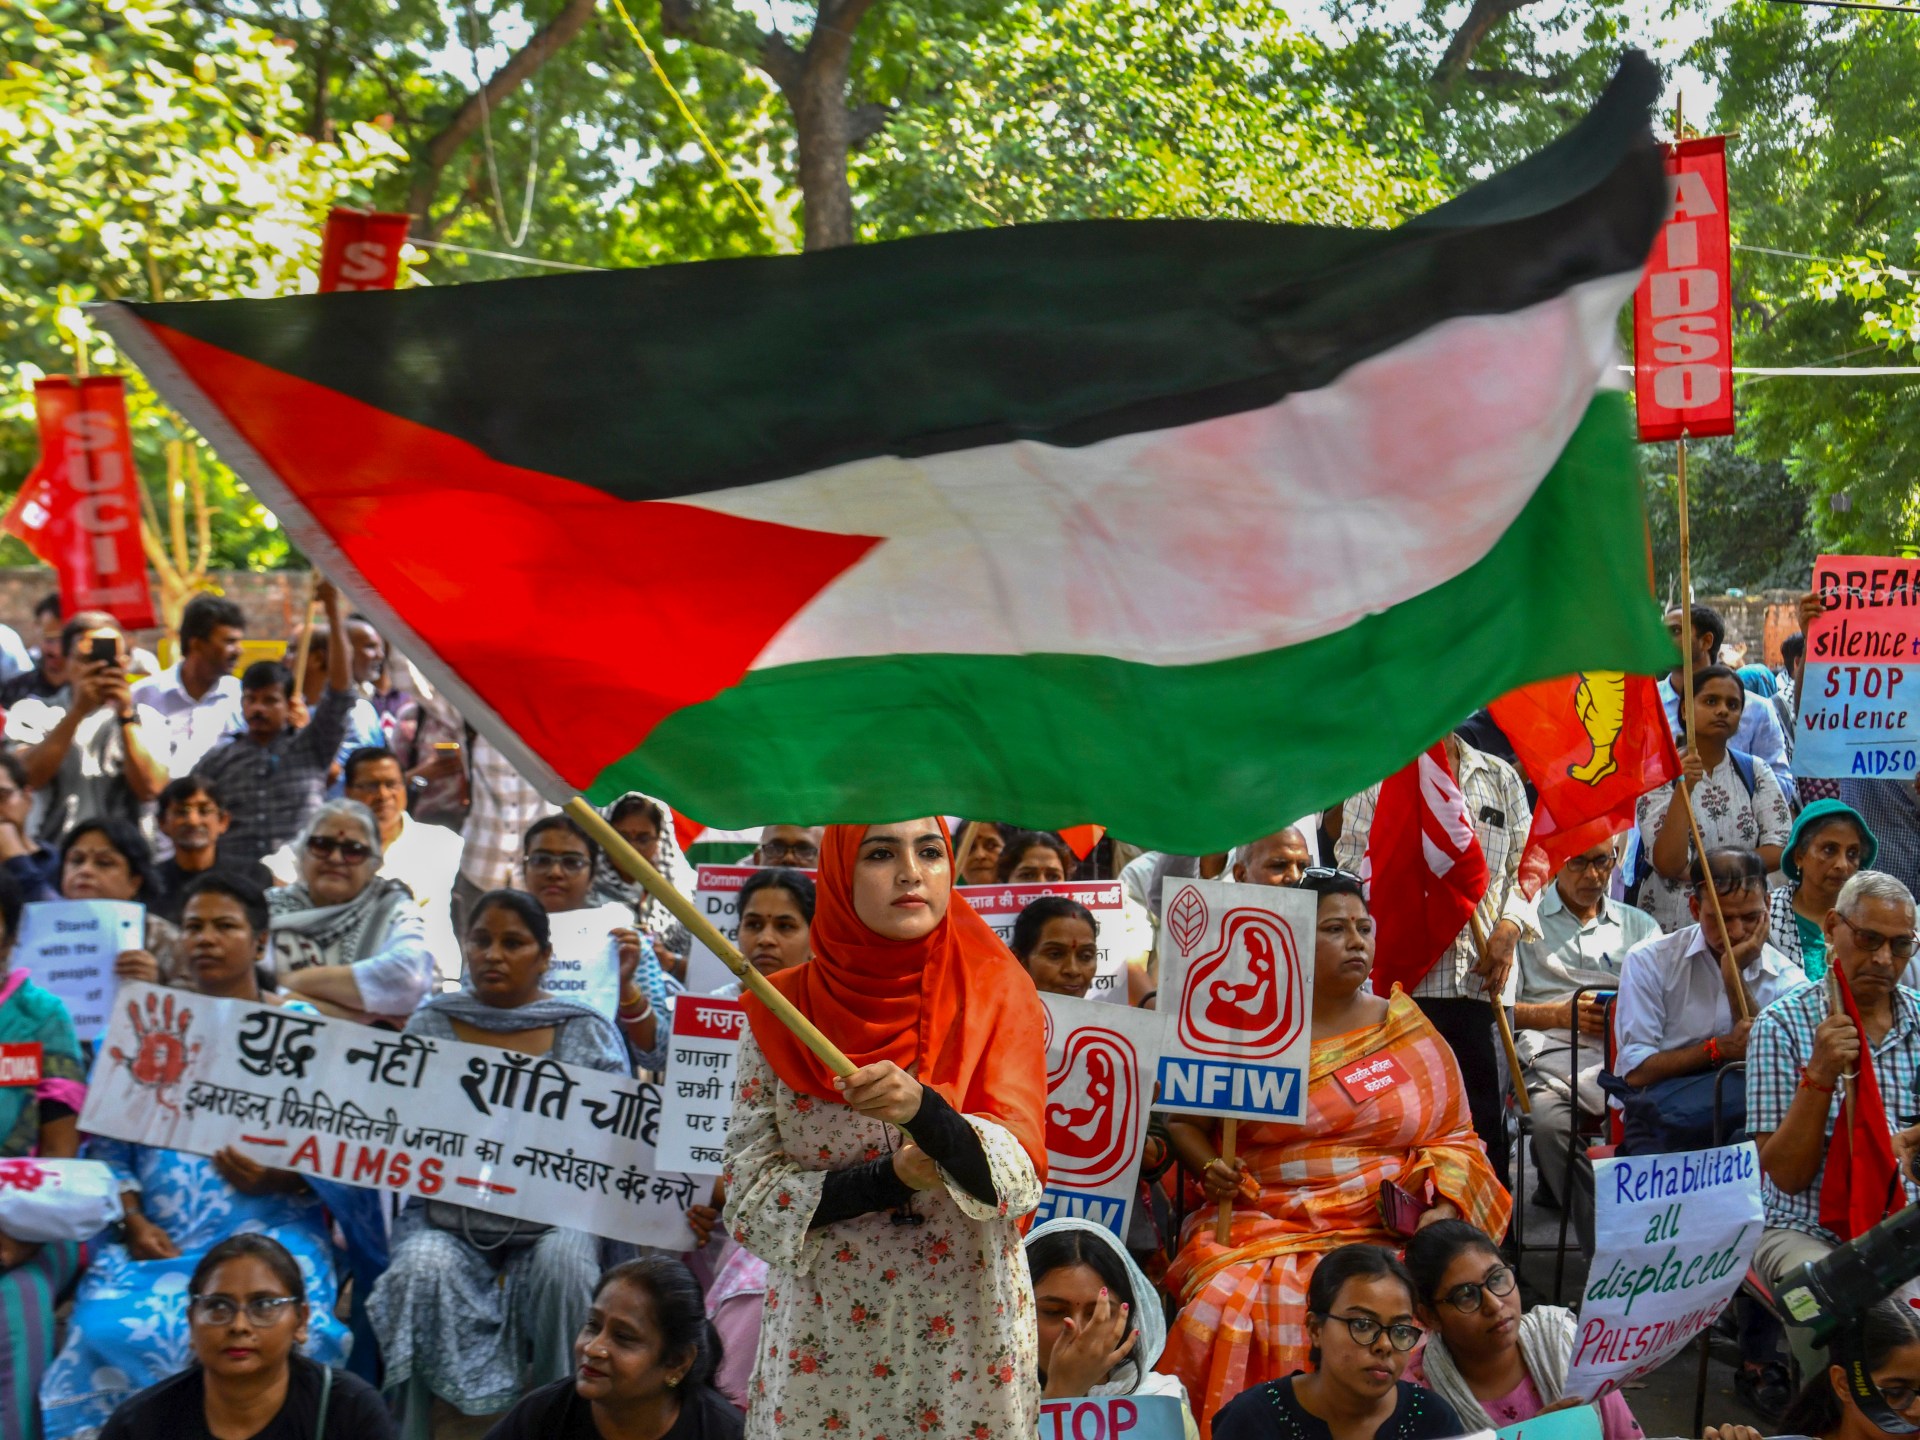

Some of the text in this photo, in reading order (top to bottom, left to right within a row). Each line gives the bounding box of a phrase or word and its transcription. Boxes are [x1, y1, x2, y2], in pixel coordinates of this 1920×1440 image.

[1650, 171, 1722, 409] AIDSO
[1814, 619, 1907, 657] silence
[1824, 666, 1904, 699] STOP
[1804, 703, 1908, 731] violence
[1851, 750, 1917, 775] AIDSO
[701, 870, 748, 888] Commu
[706, 896, 740, 915] Do
[55, 920, 99, 933] Stand
[40, 944, 99, 957] with the
[48, 967, 99, 983] people
[86, 989, 103, 1001] of
[73, 1015, 103, 1026] tine
[238, 1010, 327, 1080] युद्ध
[345, 1033, 439, 1089] नहीं
[675, 1048, 733, 1074] गाज़ा
[676, 1076, 725, 1101] सभी
[1164, 1062, 1295, 1110] NFIW
[685, 1113, 717, 1132] पर
[403, 1126, 469, 1158] जनता
[474, 1138, 504, 1166] का
[512, 1146, 615, 1195] नरसंहार
[615, 1164, 651, 1204] बंद
[650, 1171, 701, 1211] करो
[1614, 1145, 1753, 1204] Rehabilitate
[1644, 1203, 1682, 1244] all
[1586, 1225, 1749, 1316] displaced
[1573, 1298, 1729, 1368] PALESTINIANS
[1039, 1399, 1138, 1440] TOP
